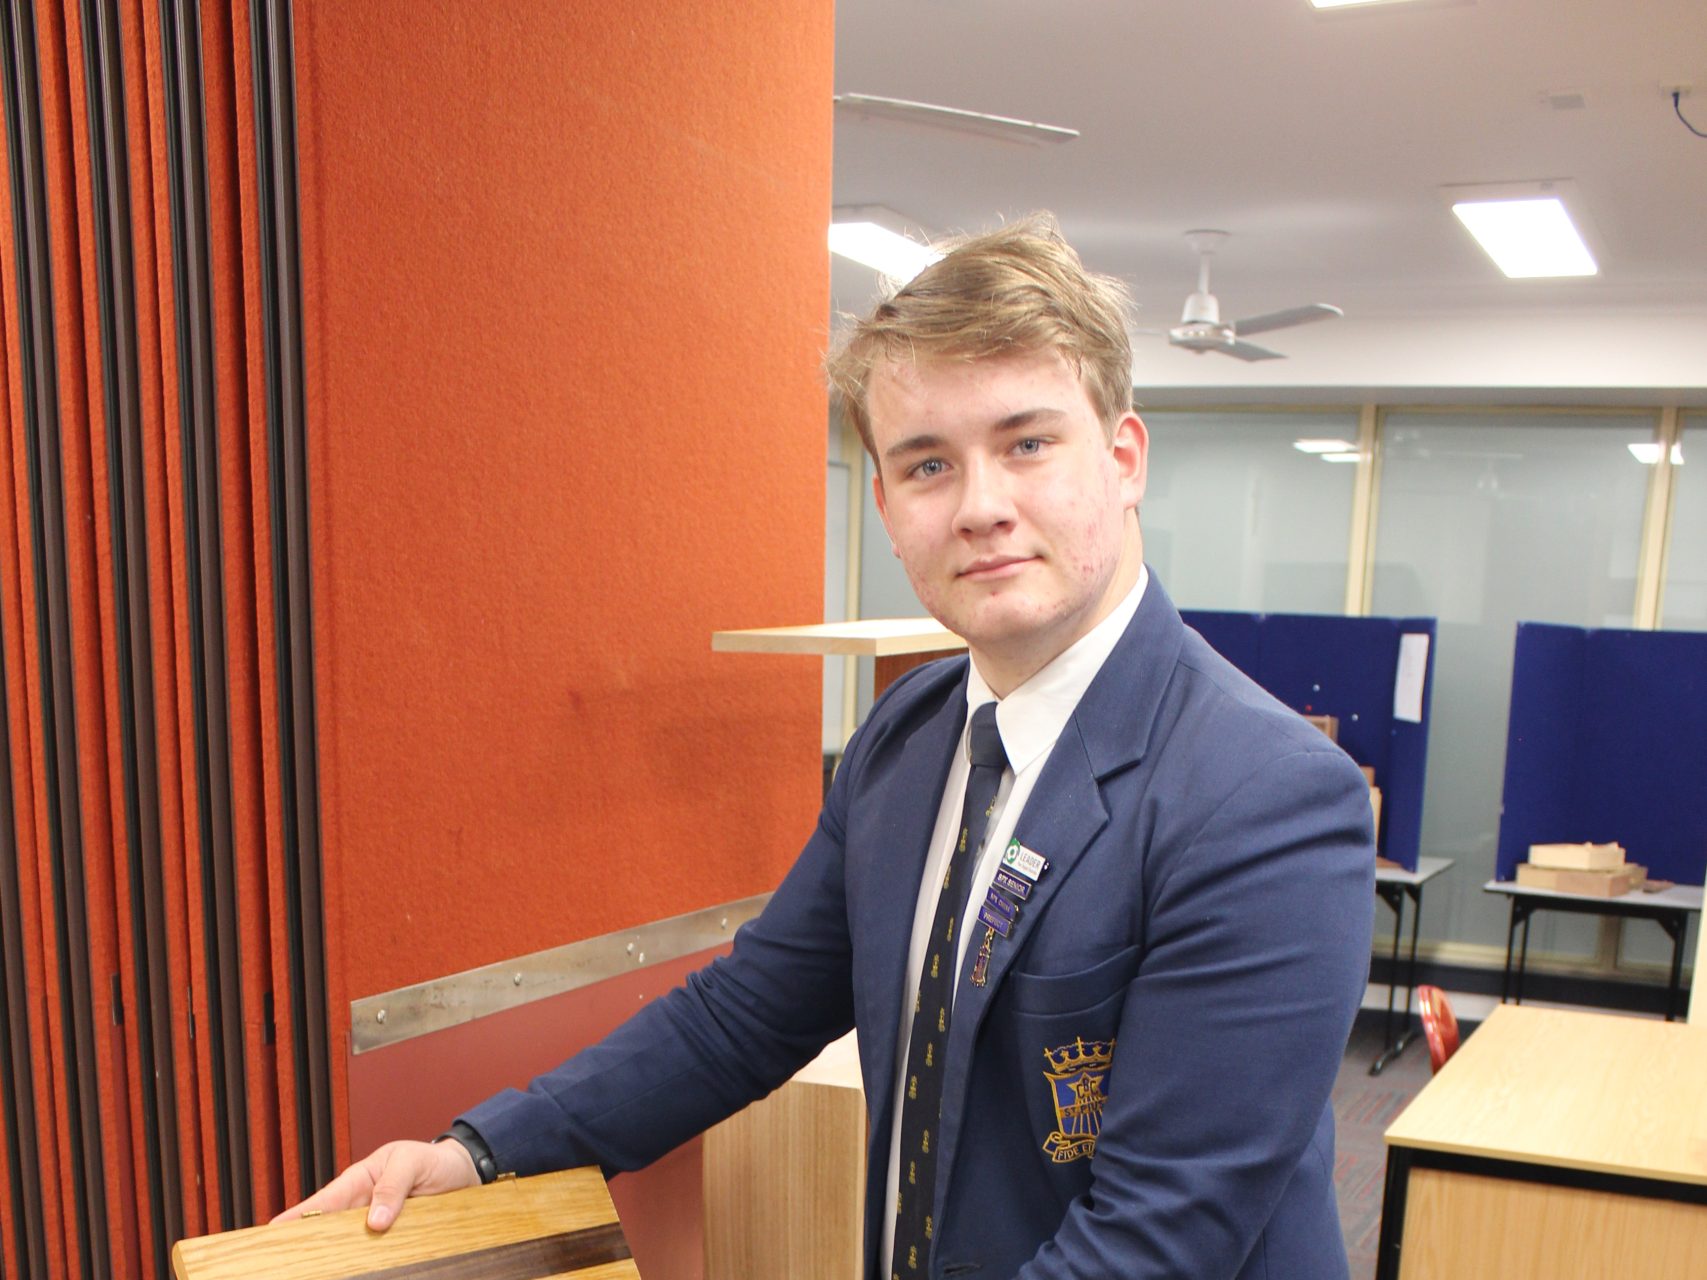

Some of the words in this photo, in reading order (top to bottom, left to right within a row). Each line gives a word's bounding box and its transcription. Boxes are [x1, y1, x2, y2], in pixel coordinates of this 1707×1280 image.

[1020, 851, 1041, 868] LEADER
[1008, 880, 1026, 895] SENIOR
[983, 912, 1003, 929] PREFECT
[1057, 1145, 1080, 1160] FIDE
